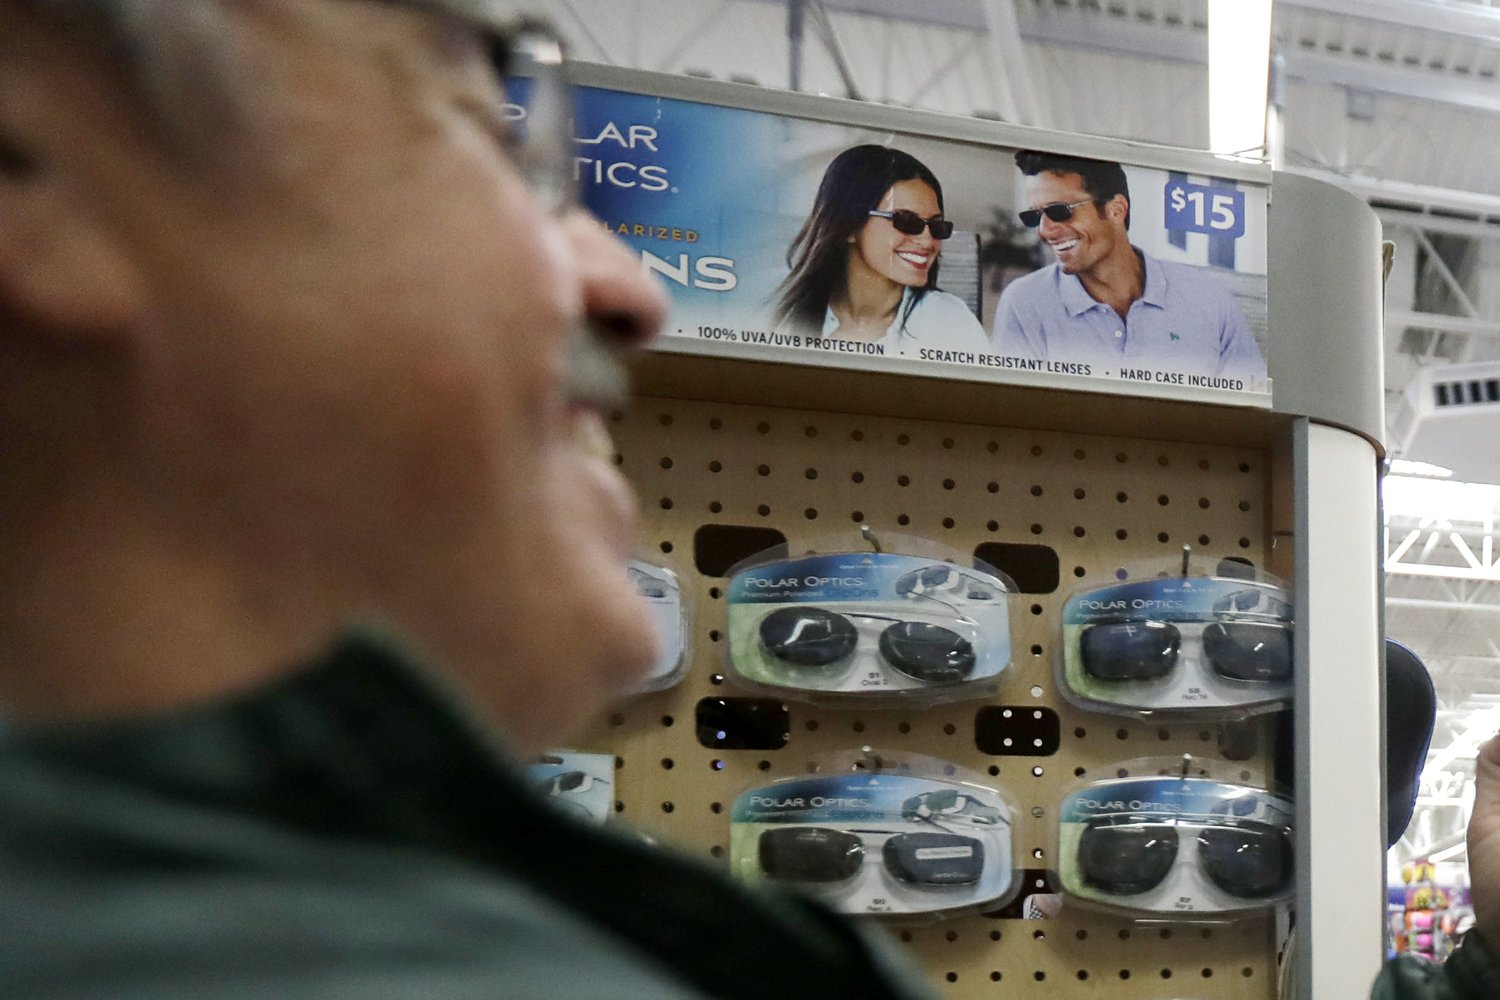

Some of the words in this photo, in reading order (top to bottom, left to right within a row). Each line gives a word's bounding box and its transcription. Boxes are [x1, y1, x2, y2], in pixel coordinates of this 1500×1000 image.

[573, 157, 671, 192] TICS
[1171, 186, 1236, 230] $15
[604, 221, 699, 243] LARIZED
[641, 250, 738, 292] NS
[698, 326, 737, 342] 100%
[741, 330, 801, 347] UVA/UVB
[805, 337, 885, 356] PROTECTION
[919, 348, 975, 364] SCRATCH
[979, 354, 1042, 371] RESISTANT
[1047, 360, 1092, 376] LENSES
[1120, 367, 1152, 382] HARD
[1155, 371, 1184, 385] CASE
[1188, 374, 1244, 391] INCLUDED
[744, 576, 798, 588] POLAR
[803, 576, 864, 587] OPTICS
[1079, 599, 1127, 610] POLAR
[1131, 598, 1184, 610] OPTICS
[750, 796, 806, 808] POLAR
[810, 796, 872, 808] OPTICS
[1075, 798, 1125, 810] POLAR
[1129, 799, 1184, 812] OPTICS
